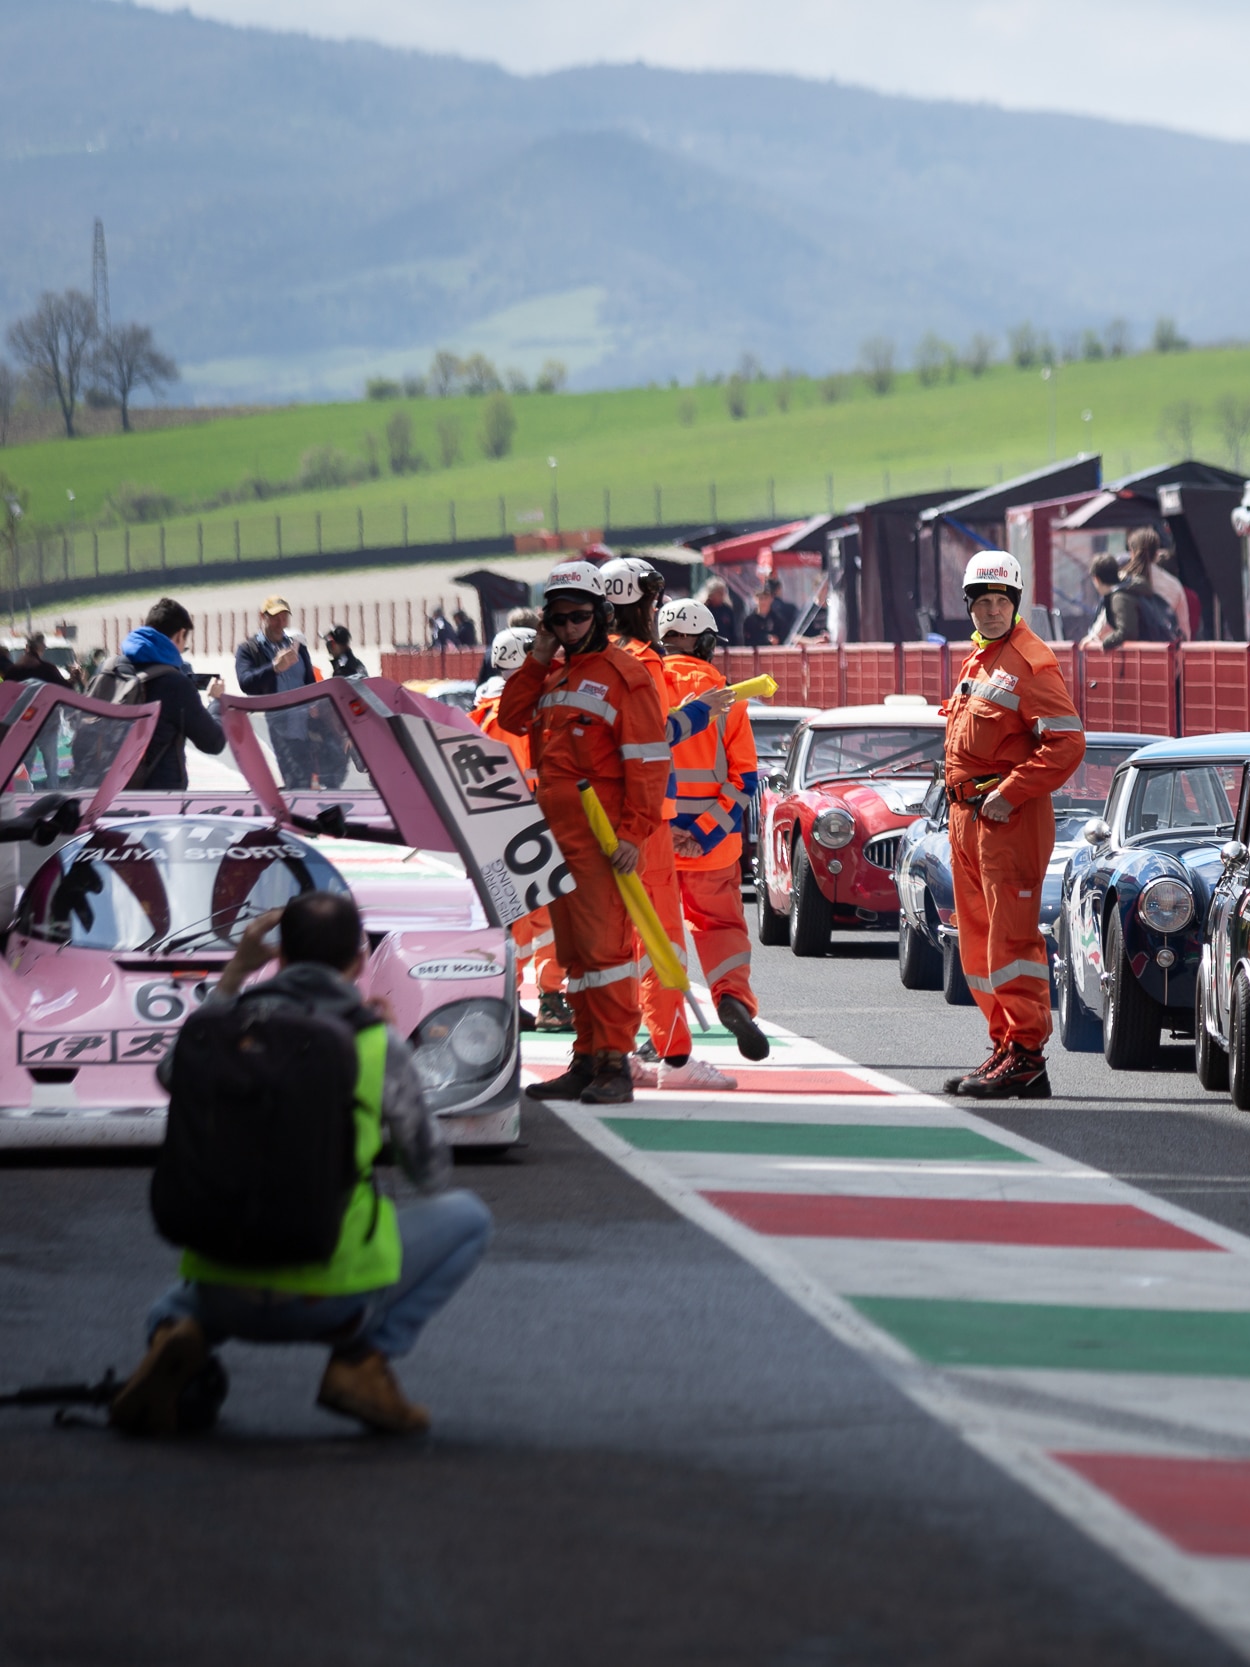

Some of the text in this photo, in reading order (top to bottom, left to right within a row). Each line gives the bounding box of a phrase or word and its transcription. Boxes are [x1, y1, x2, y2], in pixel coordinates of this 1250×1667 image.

[184, 844, 307, 861] SPORTS
[481, 863, 513, 926] HISTORIC
[491, 858, 525, 921] RACING
[135, 980, 217, 1023] 6
